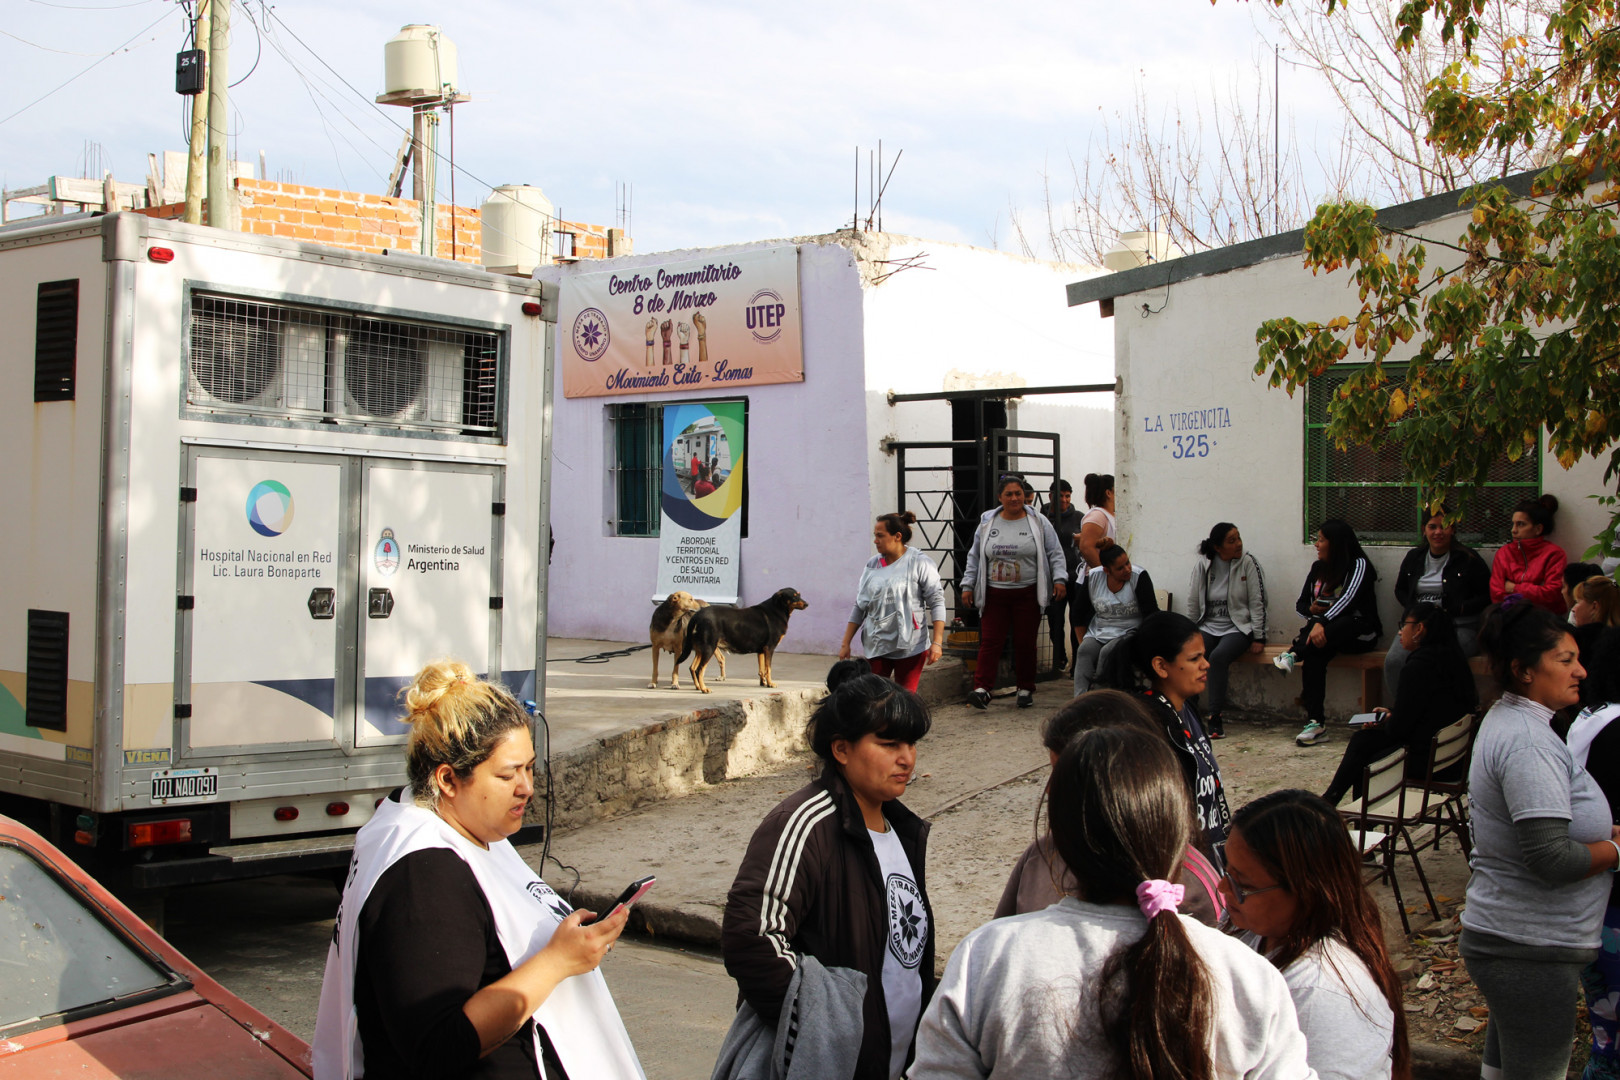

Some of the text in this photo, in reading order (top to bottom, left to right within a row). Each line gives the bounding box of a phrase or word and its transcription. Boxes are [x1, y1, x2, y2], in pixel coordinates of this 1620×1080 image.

[609, 261, 742, 296] Centro Comunitario
[632, 290, 718, 316] 8 de Marzo
[746, 303, 786, 330] UTEP
[606, 367, 670, 390] Movimiento
[672, 363, 702, 385] Evita
[712, 359, 754, 382] Lomas
[1144, 407, 1232, 433] LA VIRGENCITA
[680, 536, 716, 546] ABORDAJE
[200, 549, 332, 564] Hospital Nacional en Red
[407, 544, 485, 555] Ministerio de Salud
[676, 546, 720, 555] TERRITORIAL
[407, 558, 460, 573] Argentina
[665, 556, 729, 565] Y CENTROS EN RED
[213, 564, 321, 580] Lic. Laura Bonaparte
[680, 566, 714, 575] DE SALUD
[672, 575, 721, 585] COMUNITARIA
[153, 779, 173, 799] 101
[196, 776, 216, 796] 091
